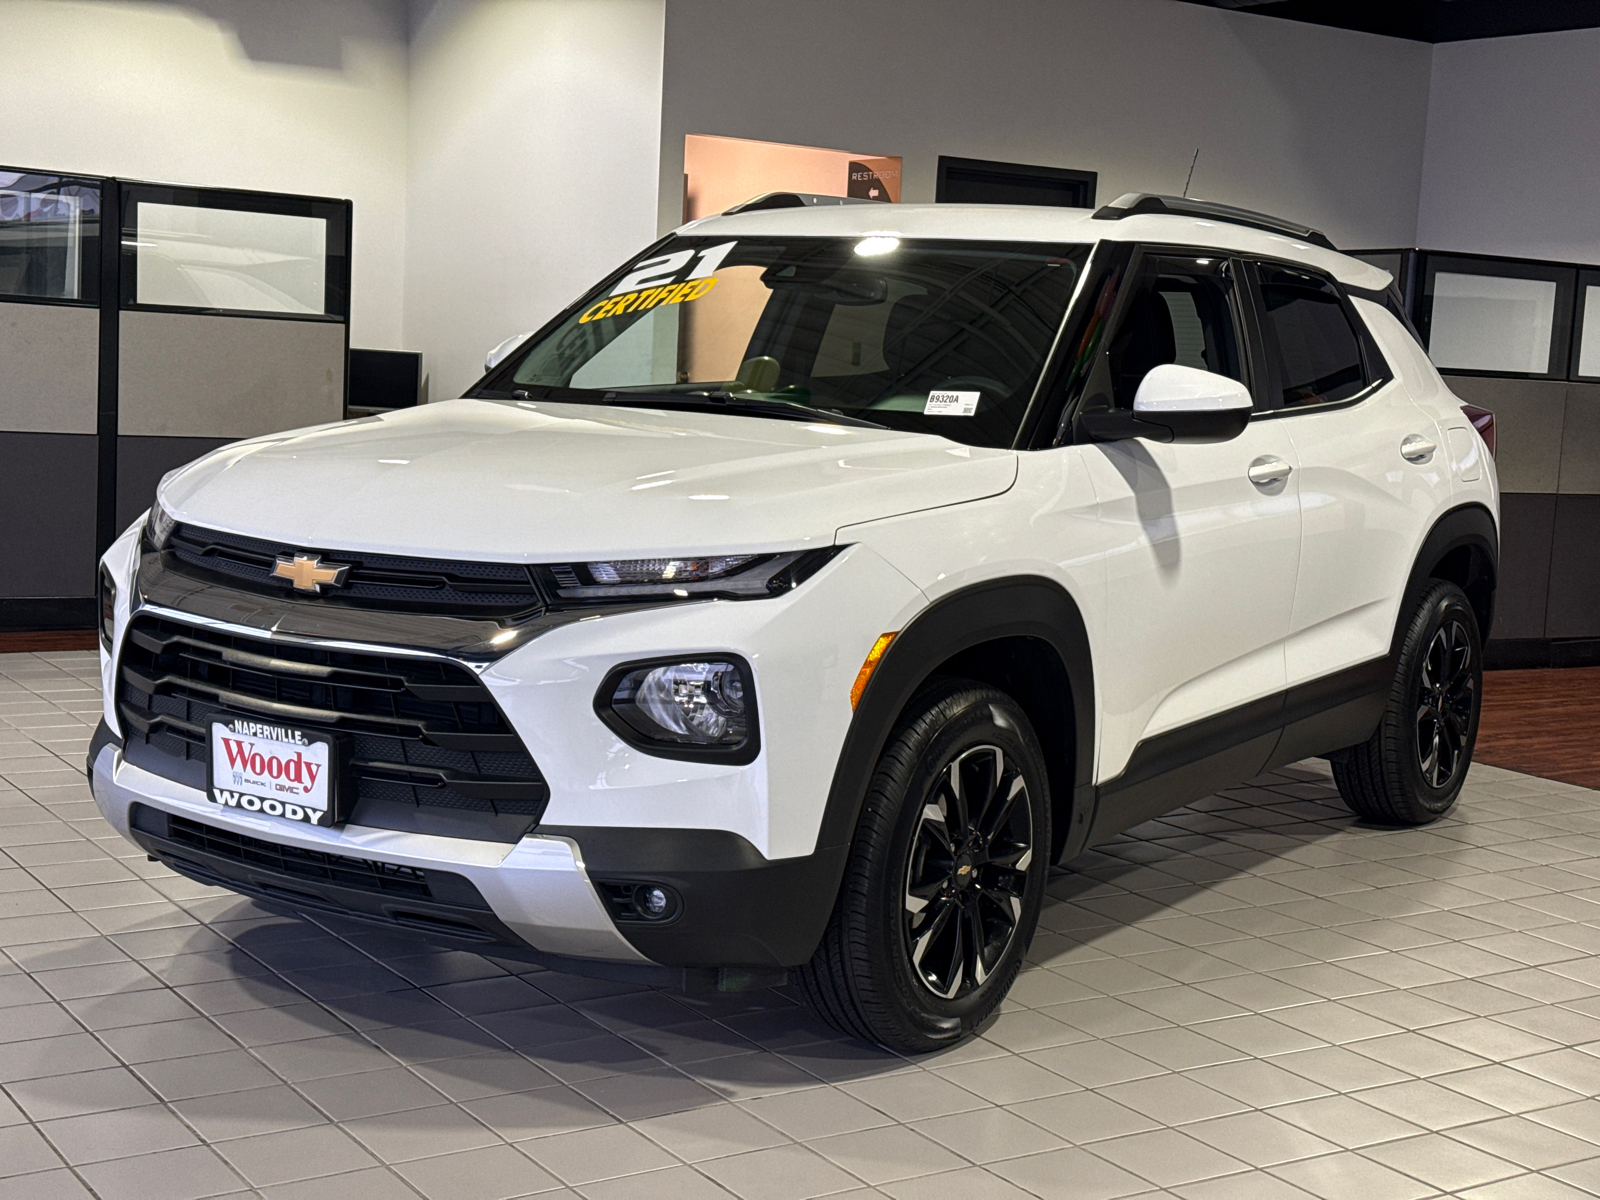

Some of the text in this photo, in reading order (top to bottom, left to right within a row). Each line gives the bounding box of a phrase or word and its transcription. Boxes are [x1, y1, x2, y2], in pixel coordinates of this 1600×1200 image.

[608, 240, 738, 297] 21
[578, 277, 718, 324] CERTIFIED
[929, 394, 959, 403] B9320A
[234, 719, 302, 745] NAPERVILLE
[220, 737, 322, 793] Woody
[243, 778, 300, 795] BUICK GMC
[212, 788, 324, 825] WOODY
